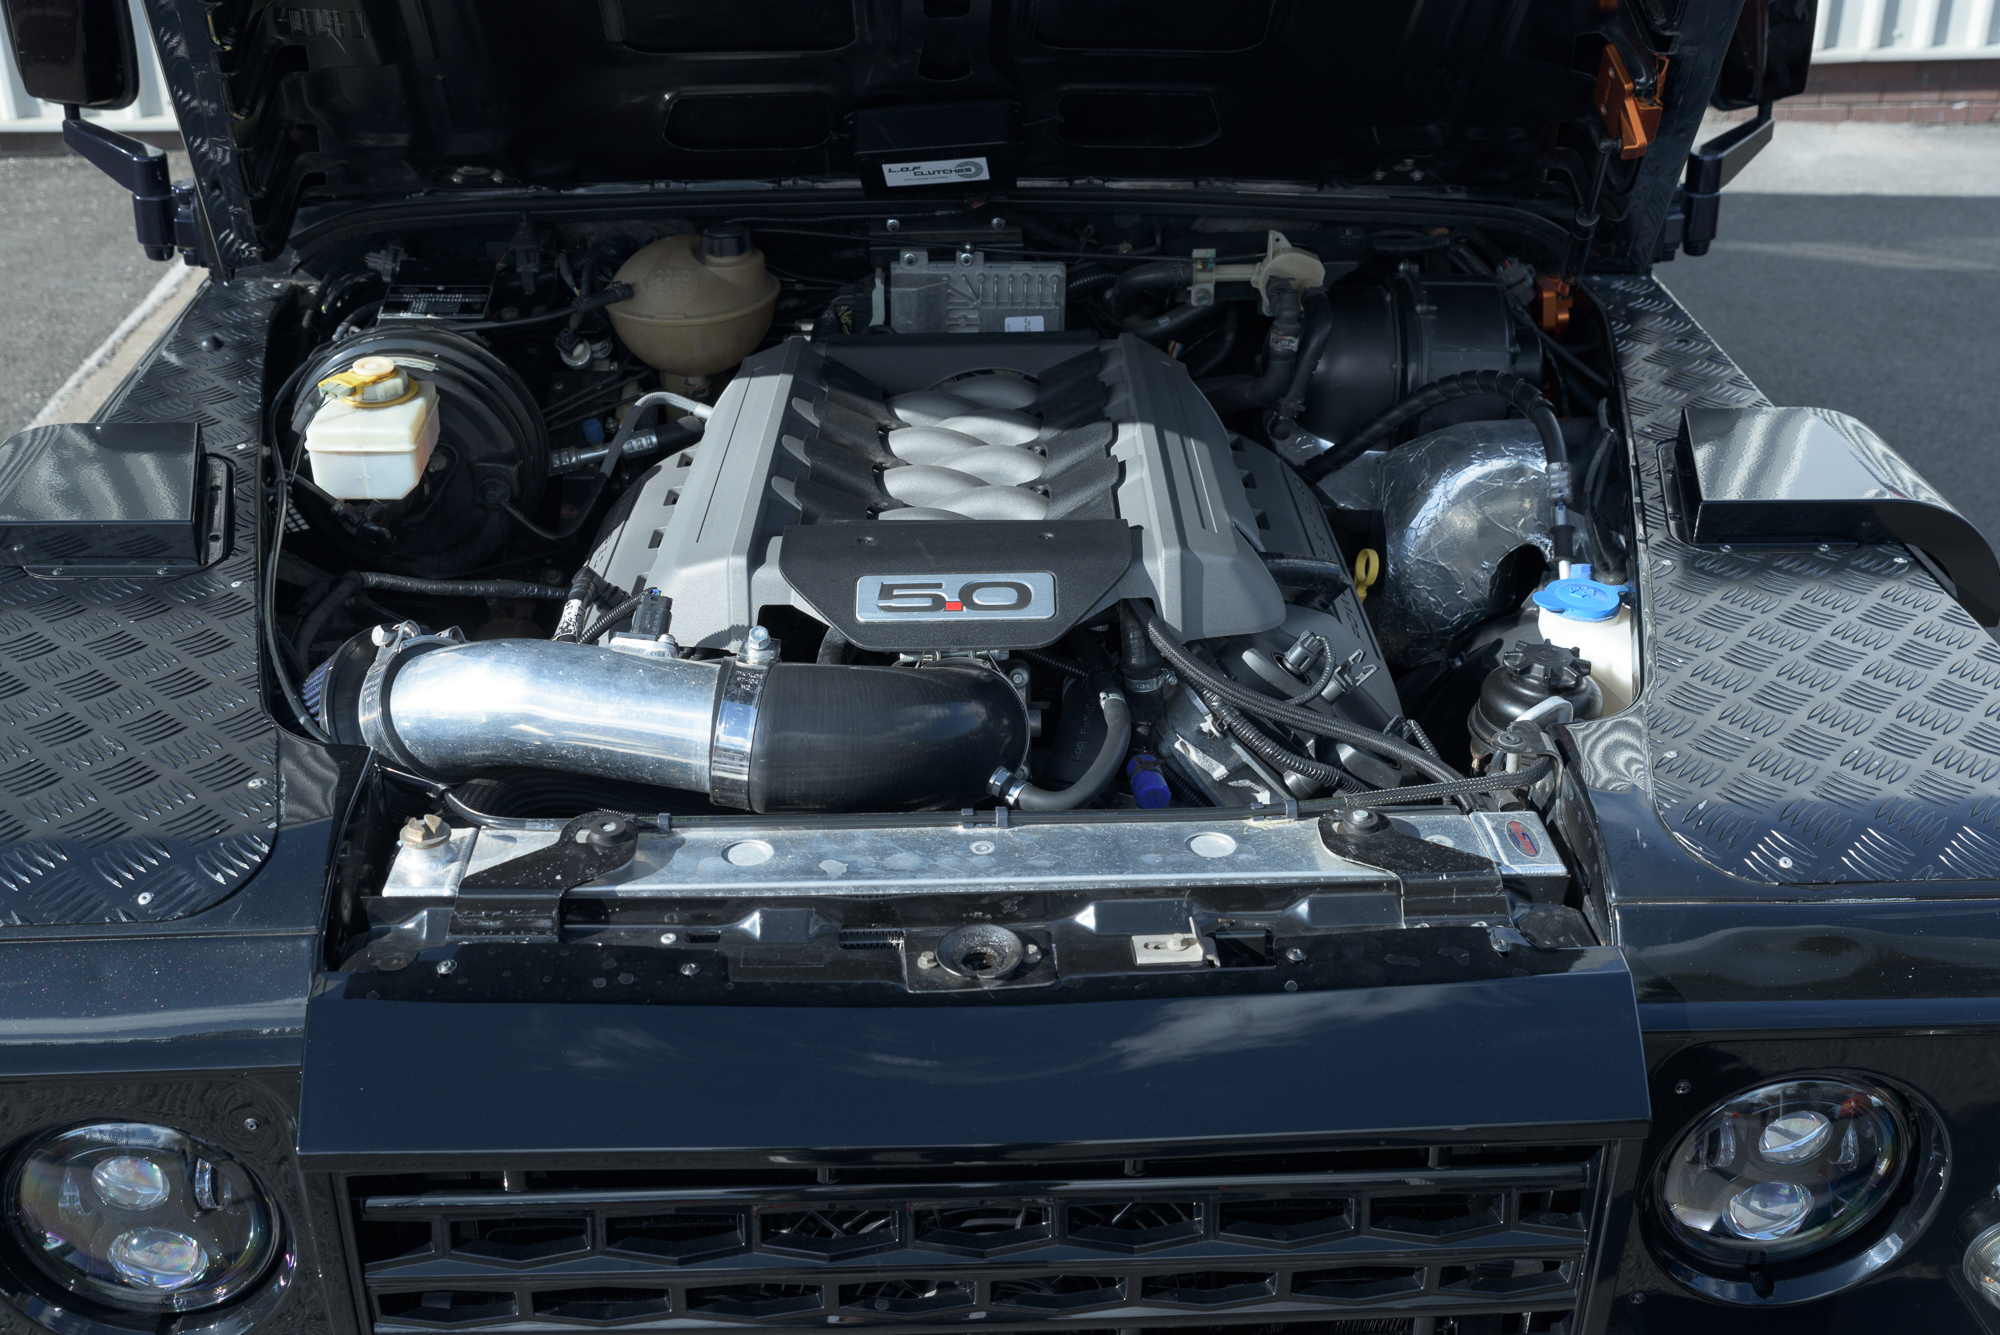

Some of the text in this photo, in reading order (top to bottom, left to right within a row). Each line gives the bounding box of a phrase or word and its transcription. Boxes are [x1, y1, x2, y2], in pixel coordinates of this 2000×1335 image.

[913, 167, 972, 176] CLUTCHES
[655, 269, 691, 281] COLD
[650, 282, 692, 295] LEVEL
[876, 580, 1035, 613] 5.0
[1080, 698, 1097, 735] FoMoCo
